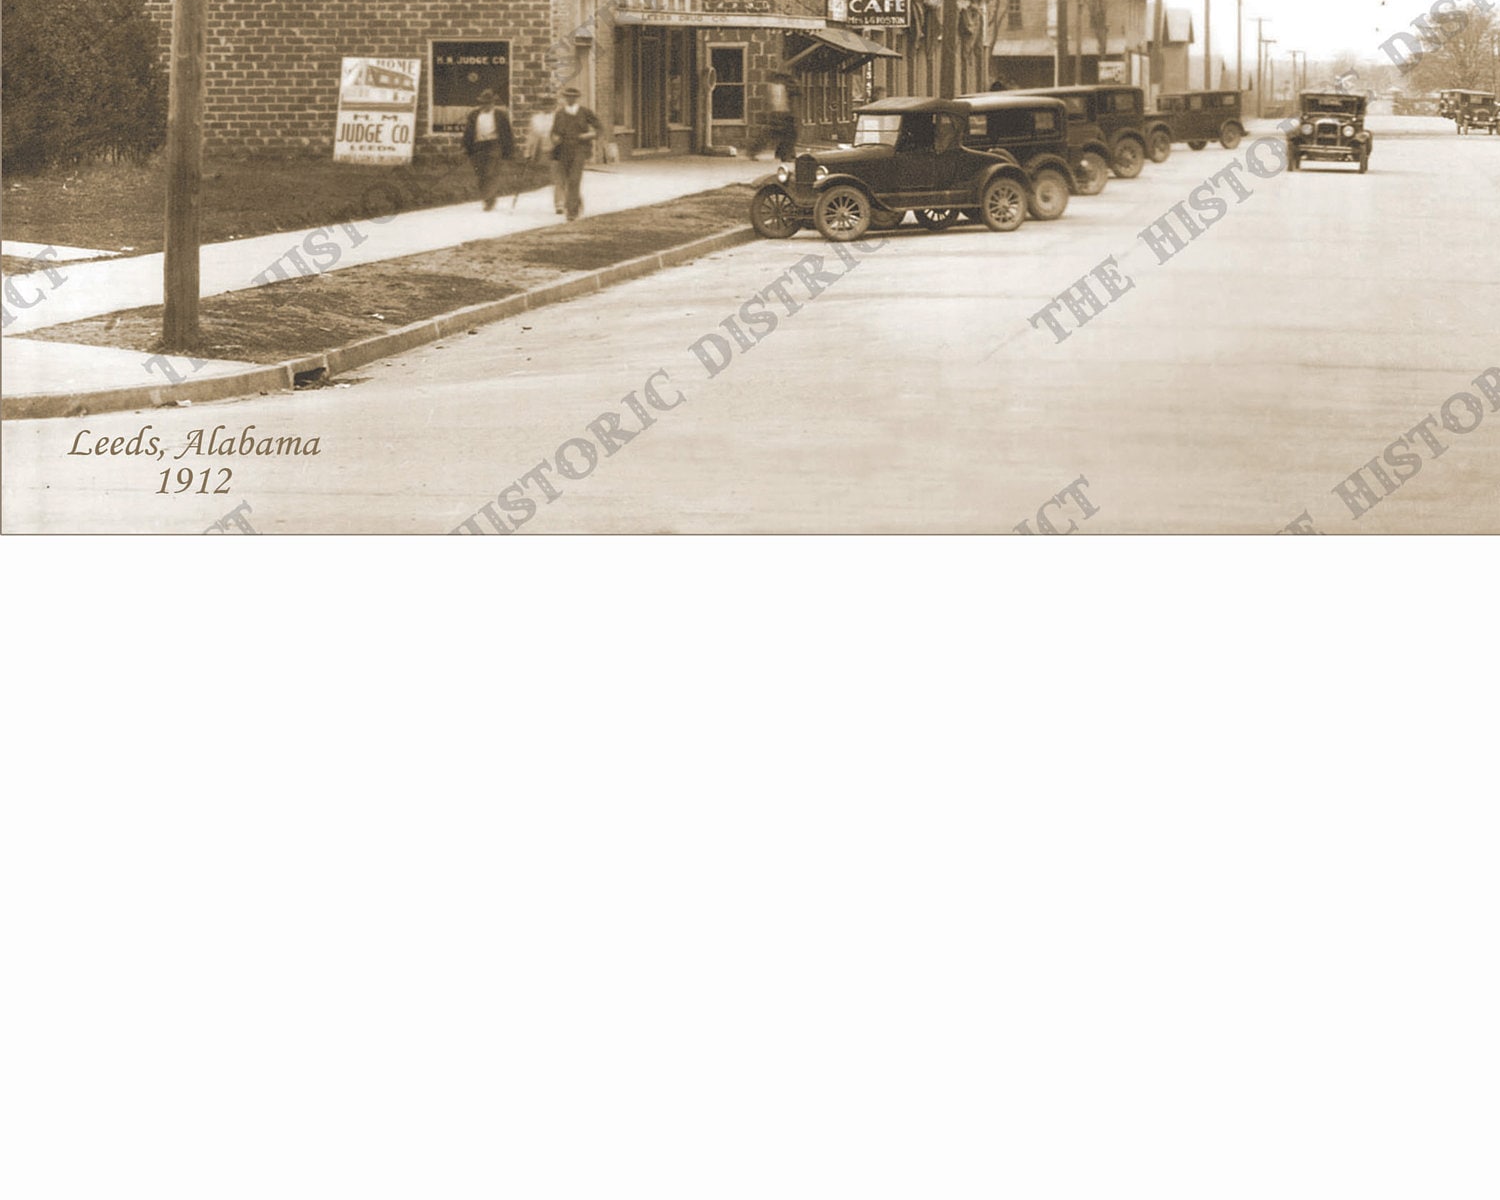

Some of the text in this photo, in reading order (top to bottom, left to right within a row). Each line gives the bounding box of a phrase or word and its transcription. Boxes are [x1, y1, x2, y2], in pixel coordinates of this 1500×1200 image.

[456, 55, 489, 65] JUDGE
[376, 59, 416, 75] HOME
[336, 122, 412, 145] JUDGE CO.
[350, 144, 397, 152] LEEDS
